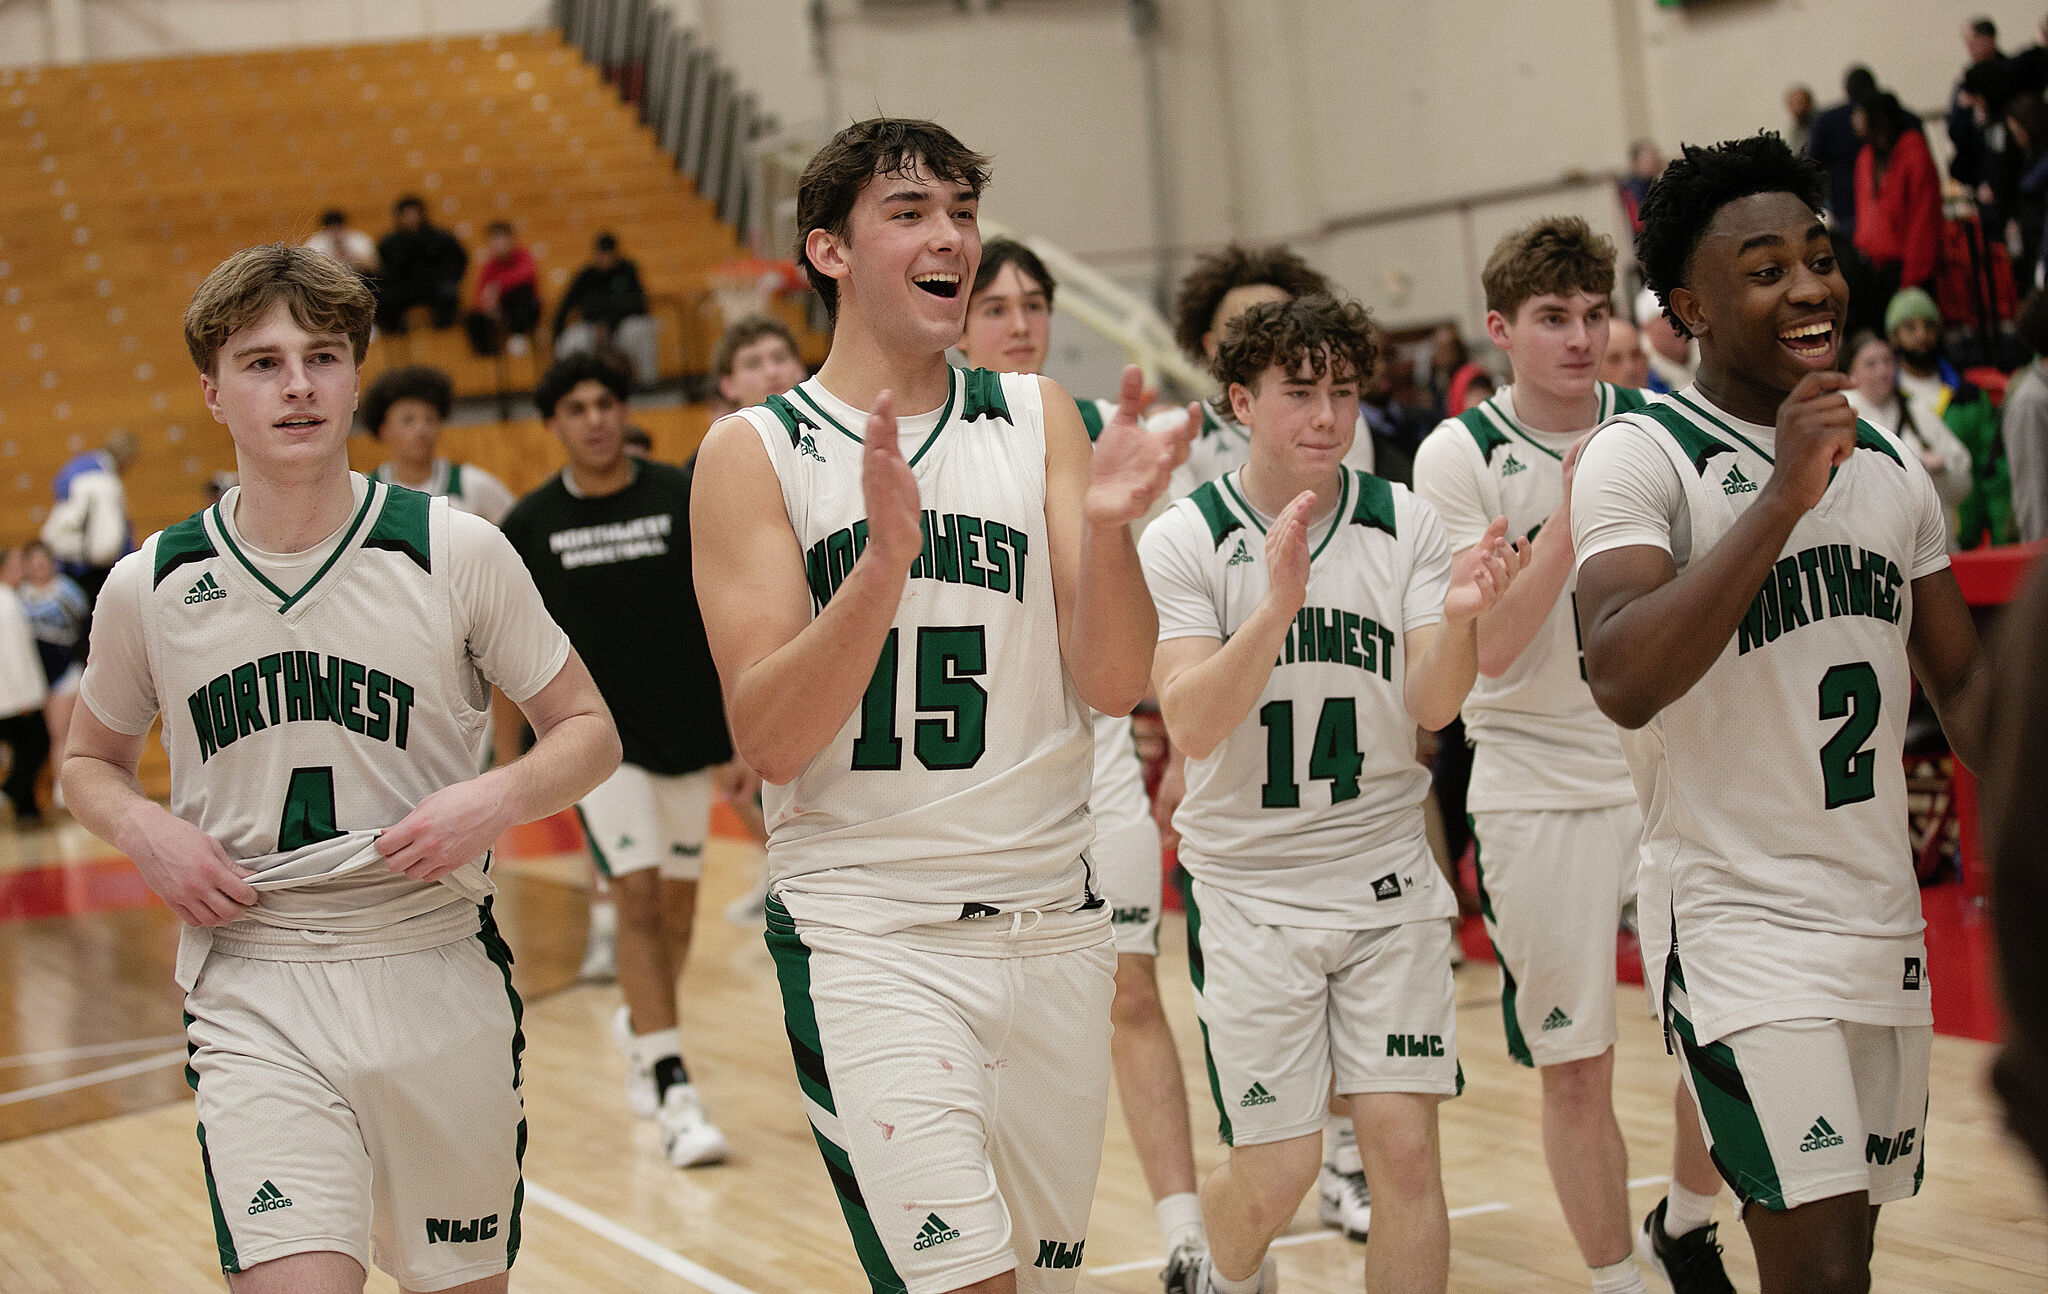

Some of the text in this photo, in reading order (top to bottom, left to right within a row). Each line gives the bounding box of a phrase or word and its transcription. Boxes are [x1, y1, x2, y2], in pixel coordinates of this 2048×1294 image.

[549, 513, 672, 554] NORTHWEST
[561, 538, 668, 570] BASKETBALL
[806, 509, 1029, 619] NOHWEST
[184, 589, 227, 605] adidas
[1738, 544, 1904, 656] NORTHWES
[1275, 607, 1395, 682] THWEST
[187, 650, 415, 764] NORTHWEST
[851, 625, 987, 771] 15
[1260, 697, 1365, 808] 14
[1818, 661, 1882, 810] 2
[278, 766, 349, 853] 4
[1386, 1034, 1445, 1057] NWC
[1240, 1095, 1277, 1108] adidas
[1800, 1134, 1844, 1153] adidas
[248, 1198, 293, 1216] adidas
[426, 1213, 499, 1245] NWC
[913, 1227, 961, 1252] adidas
